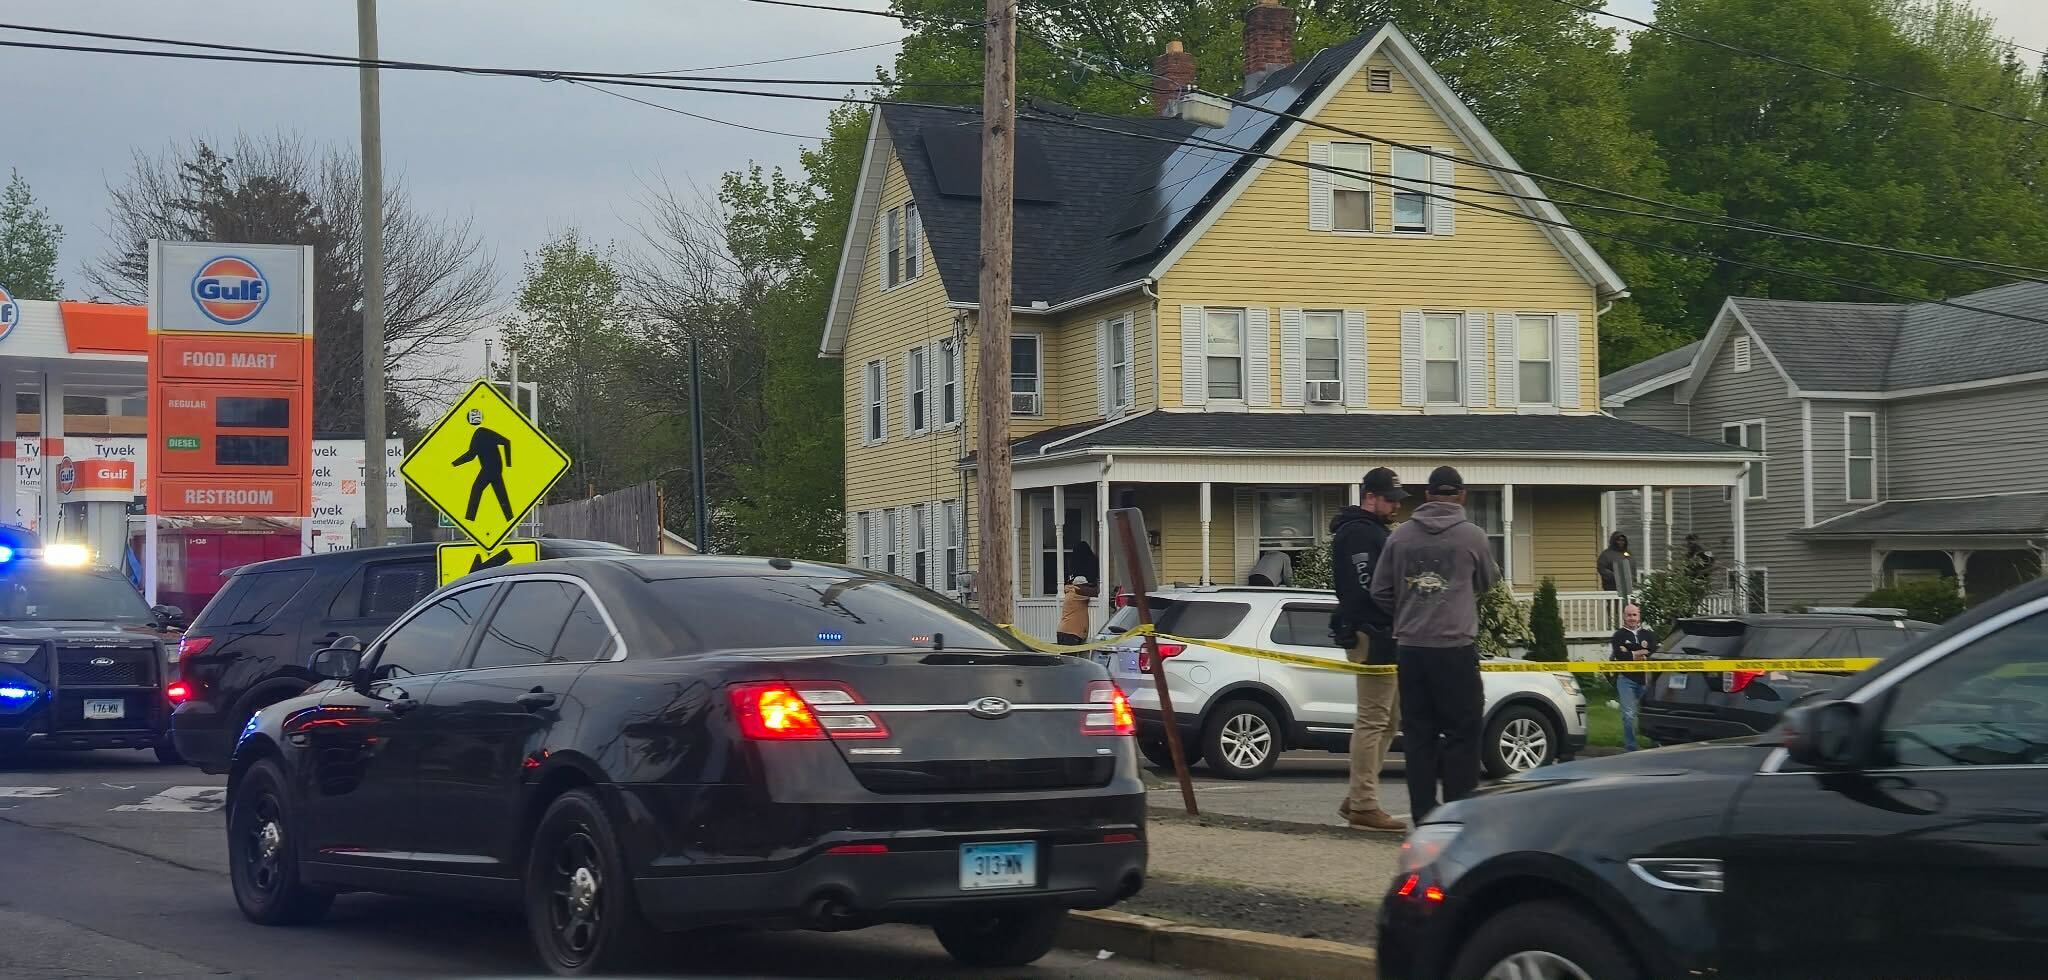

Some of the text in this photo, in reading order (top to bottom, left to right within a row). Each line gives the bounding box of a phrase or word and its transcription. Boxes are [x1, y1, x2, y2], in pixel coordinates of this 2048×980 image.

[197, 278, 262, 300] Gulf
[182, 351, 277, 369] FOOD MART
[168, 399, 206, 409] REGULAR
[169, 438, 198, 448] DIESEL
[95, 444, 135, 458] Tyvek
[314, 445, 337, 457] vek
[16, 464, 41, 479] Tyv
[61, 468, 74, 481] Gulf
[97, 468, 128, 480] Gulf
[185, 489, 274, 505] RESTROOM
[312, 504, 343, 518] yvek
